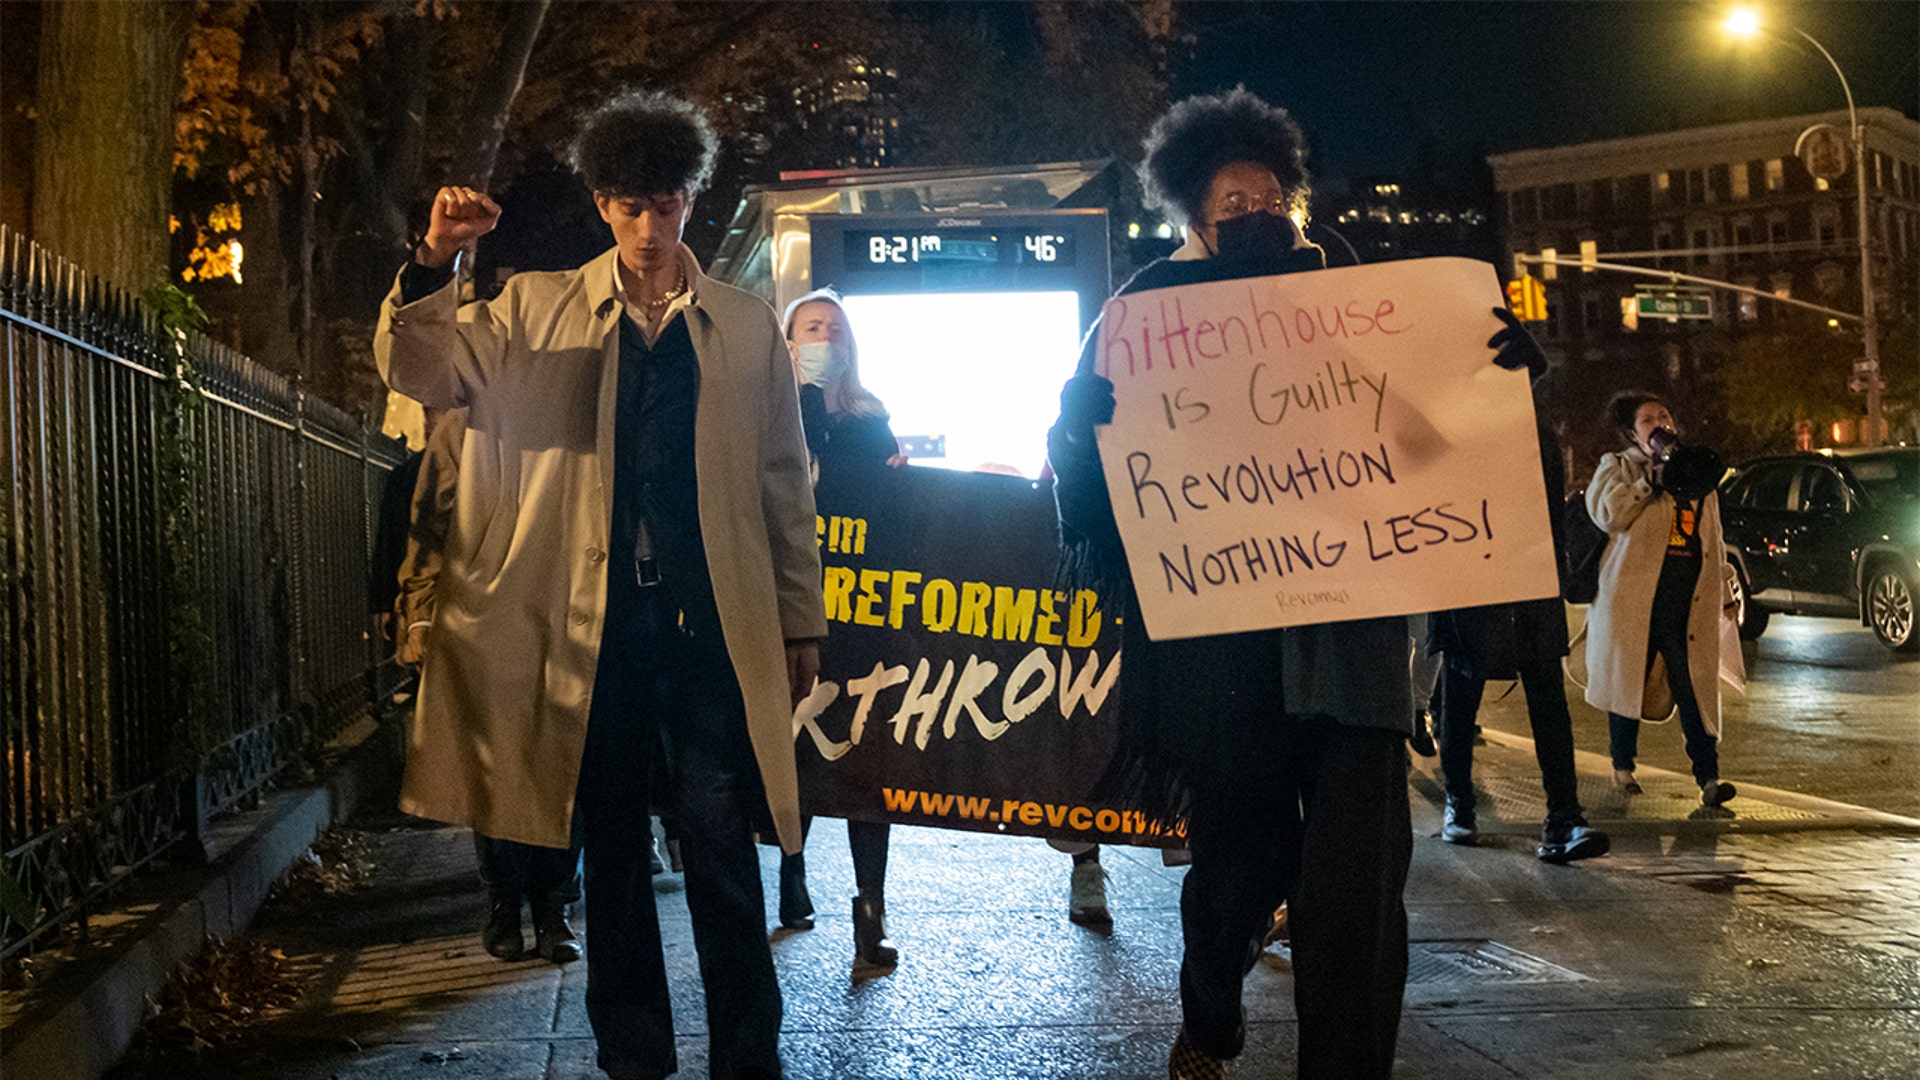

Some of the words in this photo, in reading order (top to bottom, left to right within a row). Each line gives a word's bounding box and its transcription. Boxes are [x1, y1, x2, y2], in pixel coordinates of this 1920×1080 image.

[1104, 286, 1413, 380] Rittenhouse
[1250, 361, 1387, 432] Guilty
[1159, 530, 1347, 596] NOTHING
[1364, 500, 1494, 560] LESS!
[823, 566, 1102, 648] REFORMED
